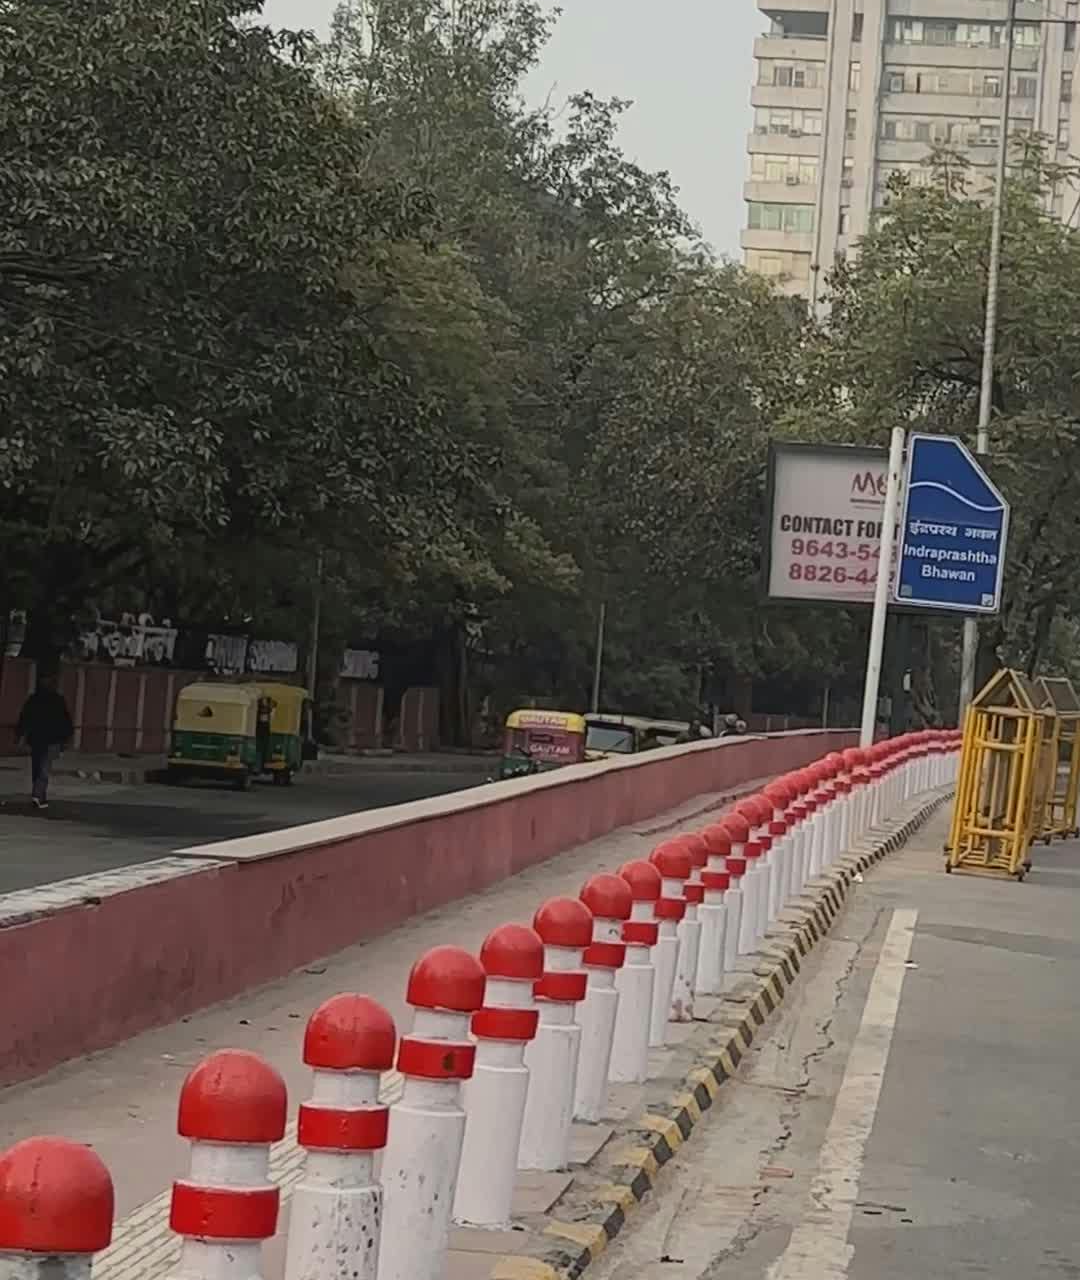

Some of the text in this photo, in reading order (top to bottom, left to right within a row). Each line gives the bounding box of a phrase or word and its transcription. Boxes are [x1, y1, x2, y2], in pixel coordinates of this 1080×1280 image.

[781, 514, 854, 537] CONTACT
[791, 538, 897, 562] 9643-54
[903, 543, 998, 565] Indraprashtha
[921, 564, 976, 582] Bhawan
